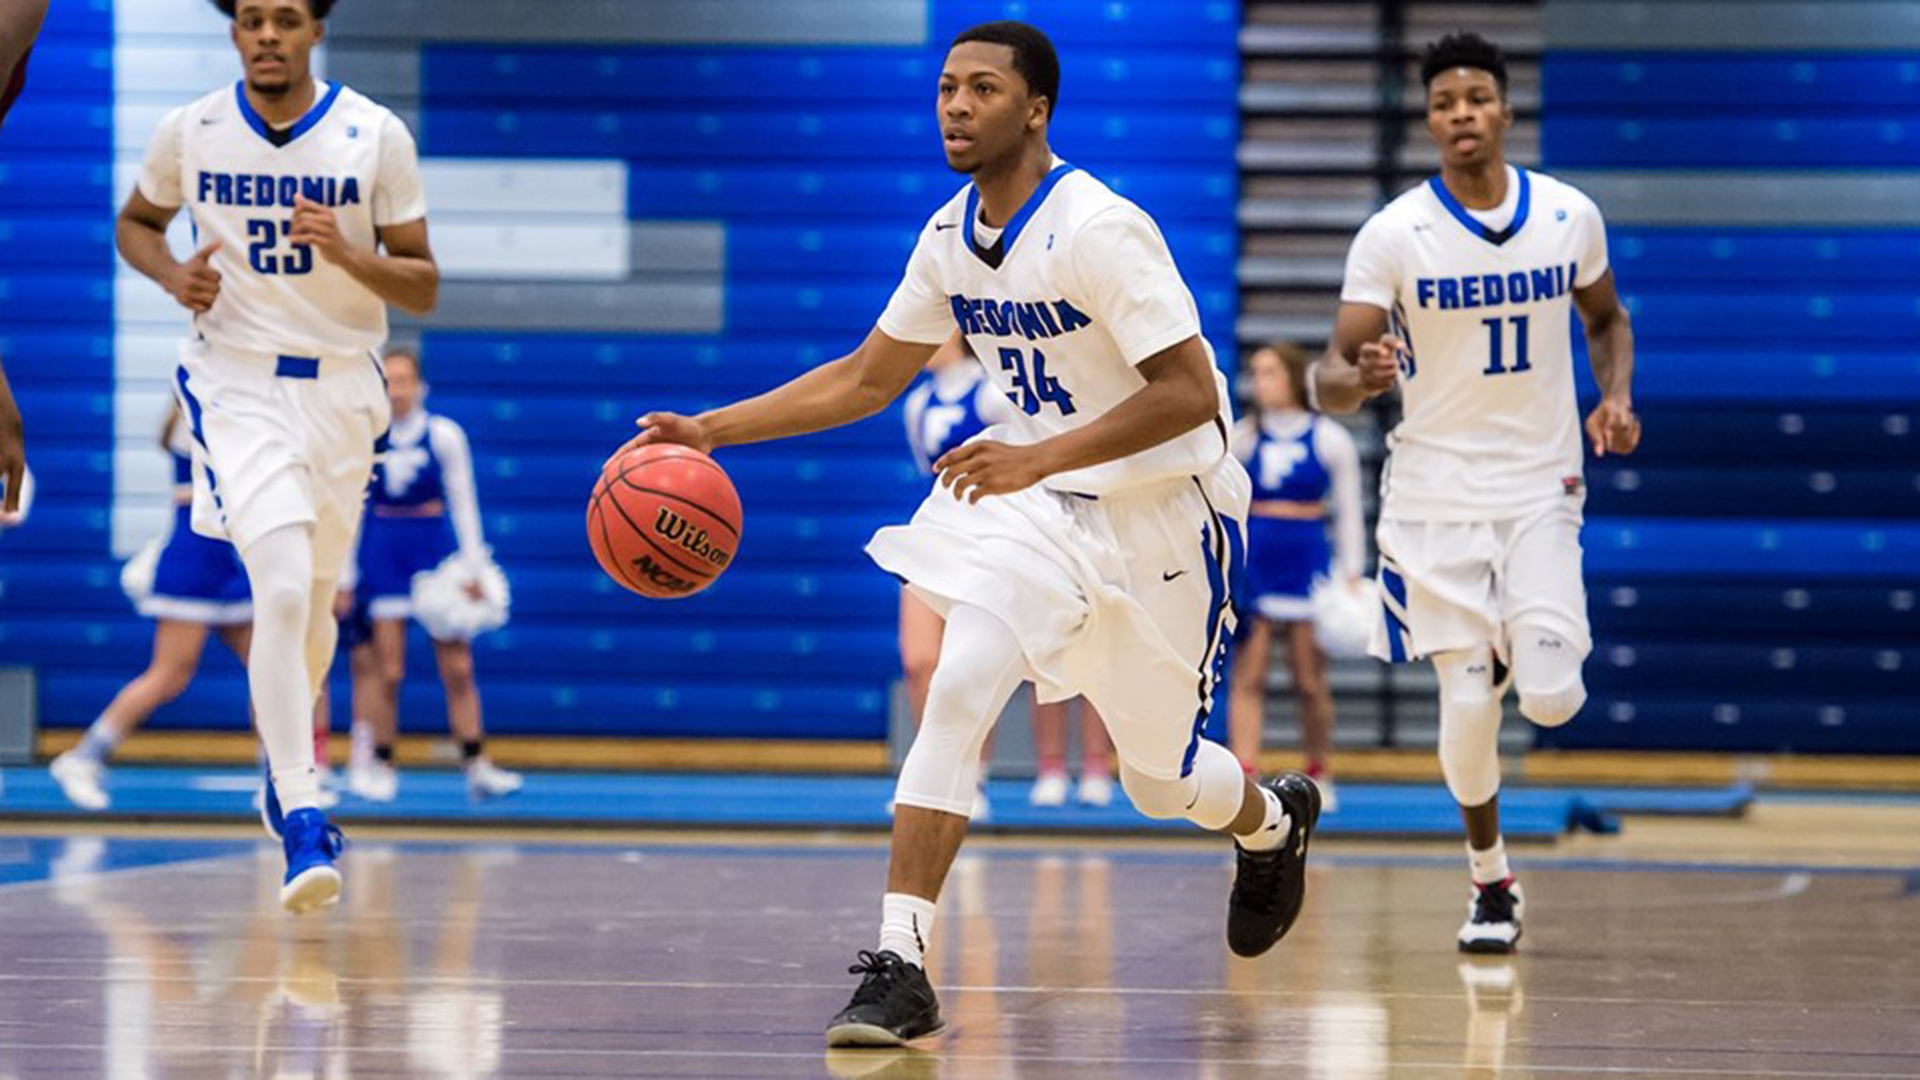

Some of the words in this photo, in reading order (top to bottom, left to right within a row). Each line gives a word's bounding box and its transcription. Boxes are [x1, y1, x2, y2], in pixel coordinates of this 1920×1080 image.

[198, 170, 360, 207] FREDONIA
[247, 218, 313, 275] 23
[950, 293, 1093, 341] REDONIA
[1481, 314, 1532, 376] 11
[998, 347, 1077, 416] 34
[654, 506, 730, 569] Wilson
